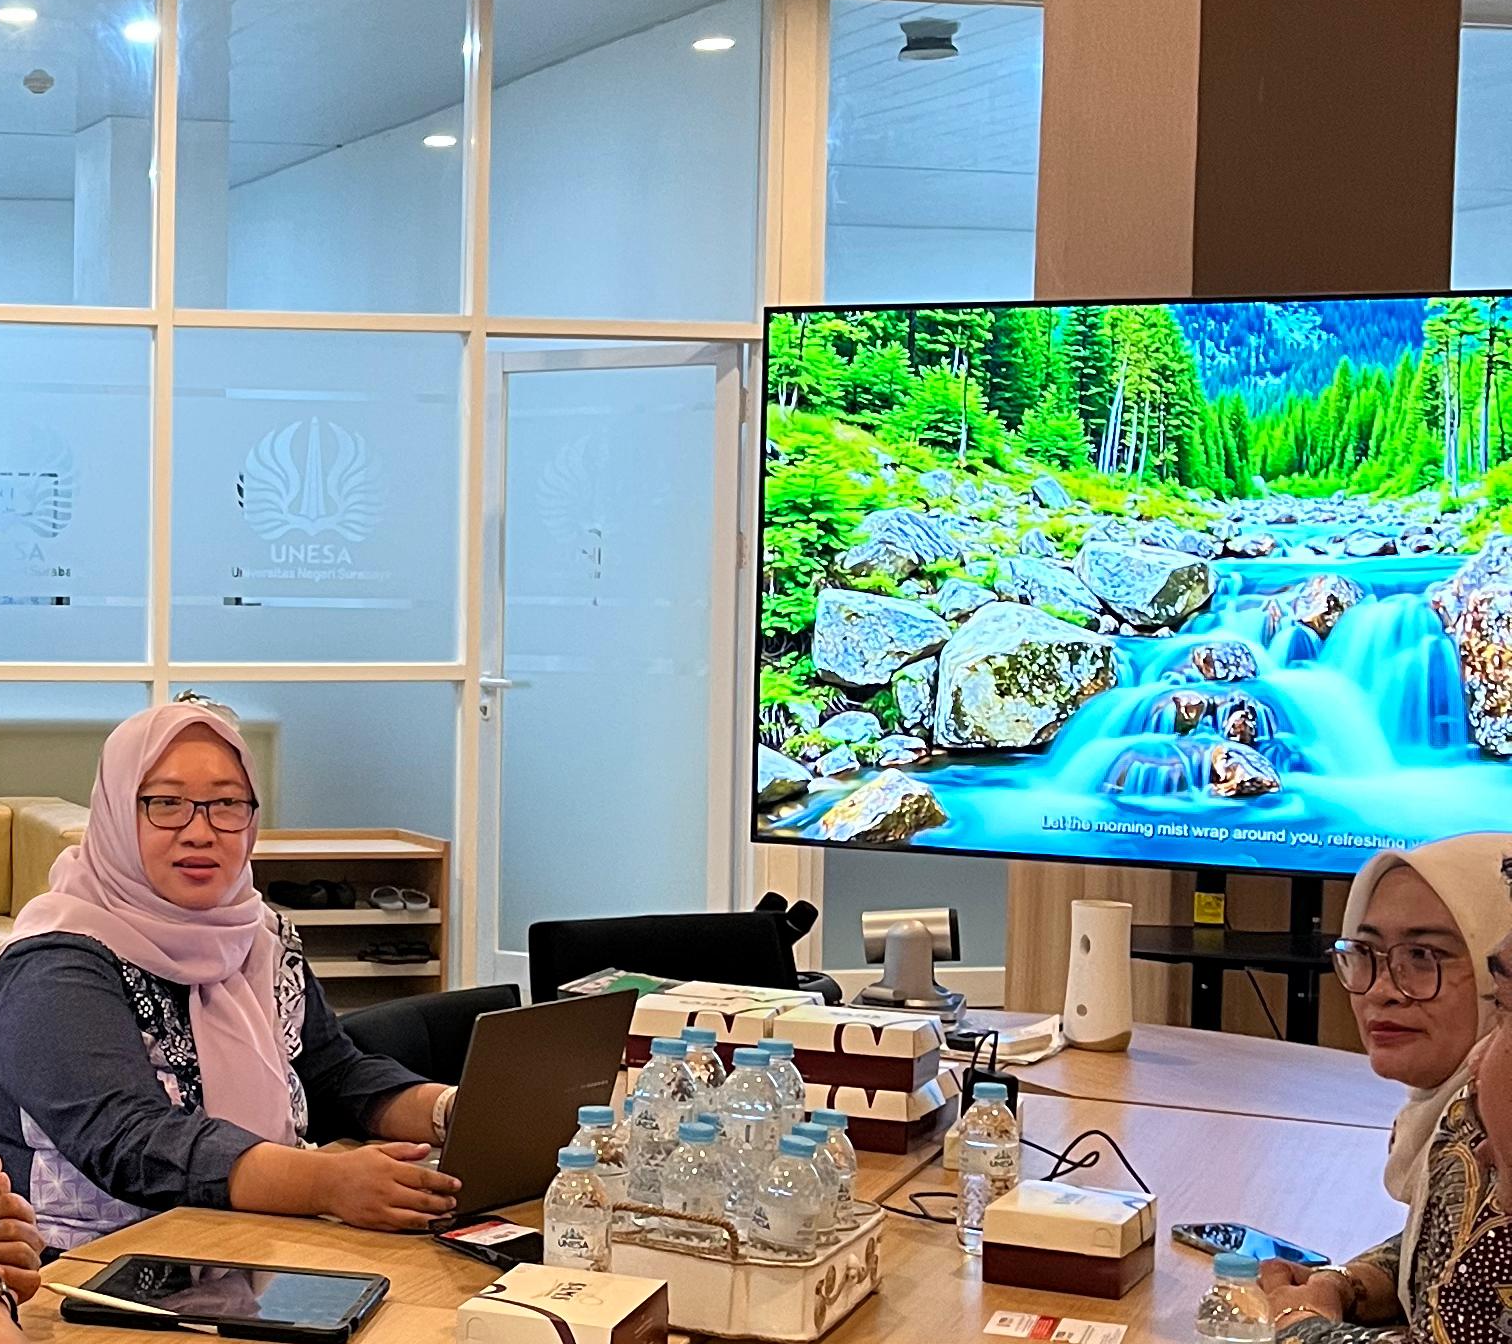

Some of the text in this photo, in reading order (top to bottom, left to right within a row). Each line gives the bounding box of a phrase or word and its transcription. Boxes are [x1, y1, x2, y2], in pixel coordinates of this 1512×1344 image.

[270, 544, 353, 565] UNESA
[1041, 815, 1065, 830] Let
[1066, 816, 1092, 831] the
[1096, 819, 1154, 838] morning
[1157, 821, 1189, 837] mist
[1191, 826, 1229, 842] wrap
[1233, 828, 1286, 843] around
[1290, 831, 1323, 848] you,
[1328, 833, 1406, 850] refreshing
